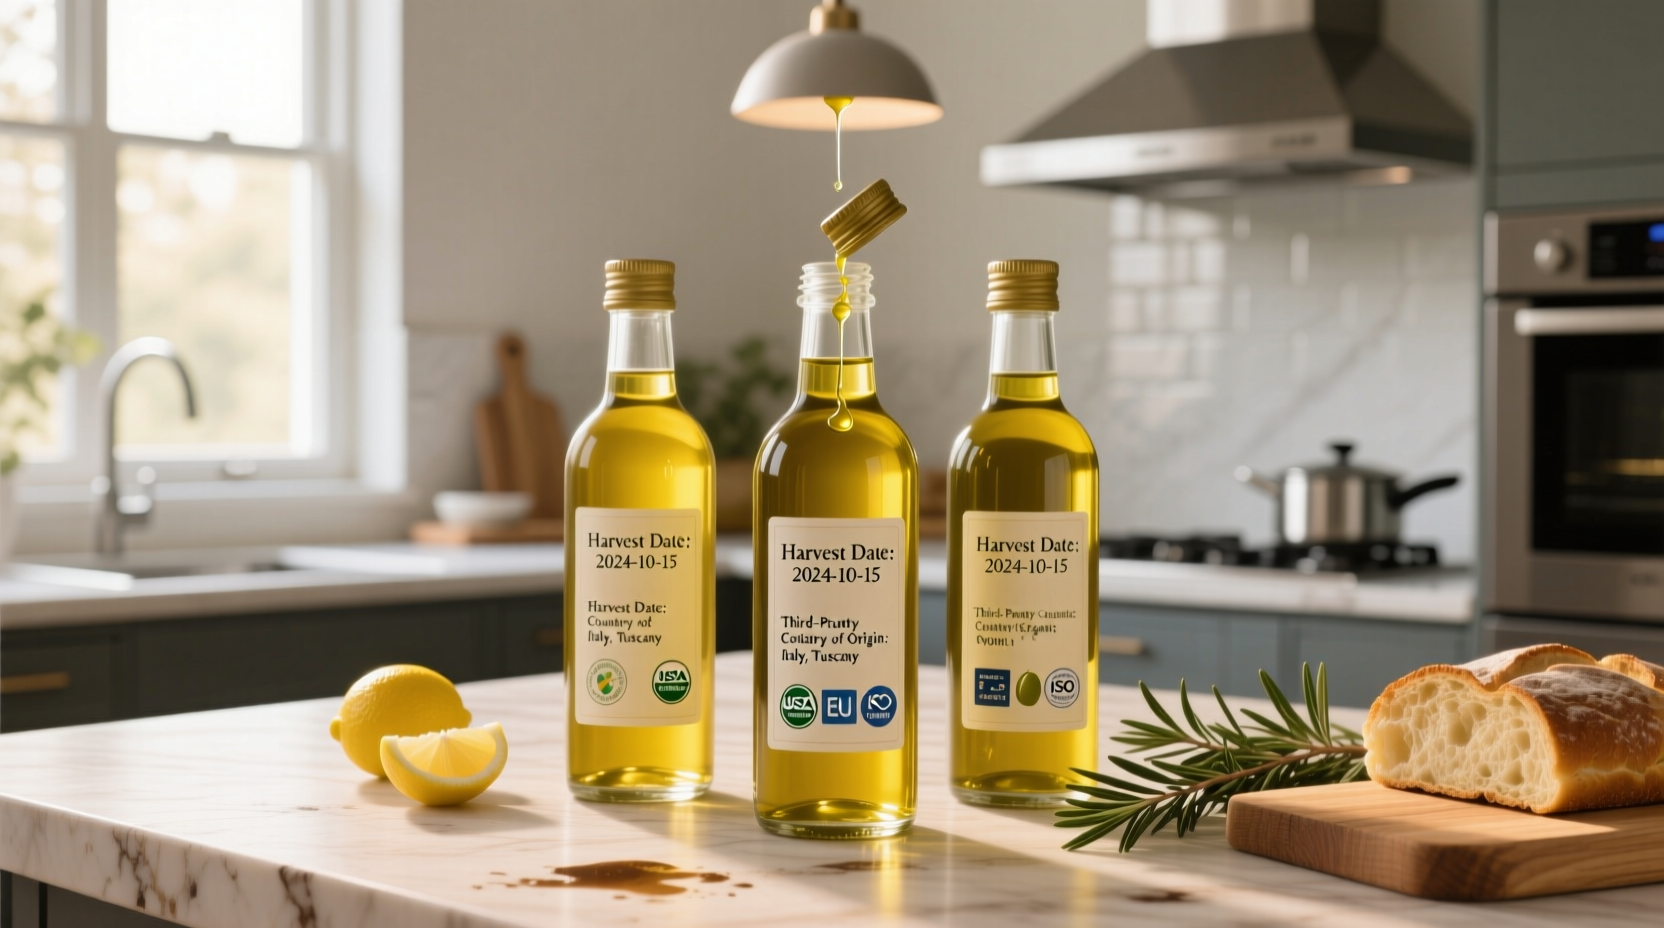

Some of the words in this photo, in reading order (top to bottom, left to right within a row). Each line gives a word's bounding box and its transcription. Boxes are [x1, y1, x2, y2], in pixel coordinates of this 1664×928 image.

[588, 532, 644, 548] Harvest
[650, 533, 690, 549] Date:
[977, 536, 1035, 552] Harvest
[1041, 537, 1079, 552] Date:
[781, 543, 845, 560] Harvest
[851, 543, 894, 560] Date:
[596, 554, 677, 569] 2024-10-15
[985, 558, 1068, 573] 2024-10-15
[792, 566, 880, 582] 2024-10-15
[831, 632, 844, 644] of
[847, 632, 888, 647] Origin:
[1051, 680, 1075, 693] ISO
[827, 696, 851, 717] EU
